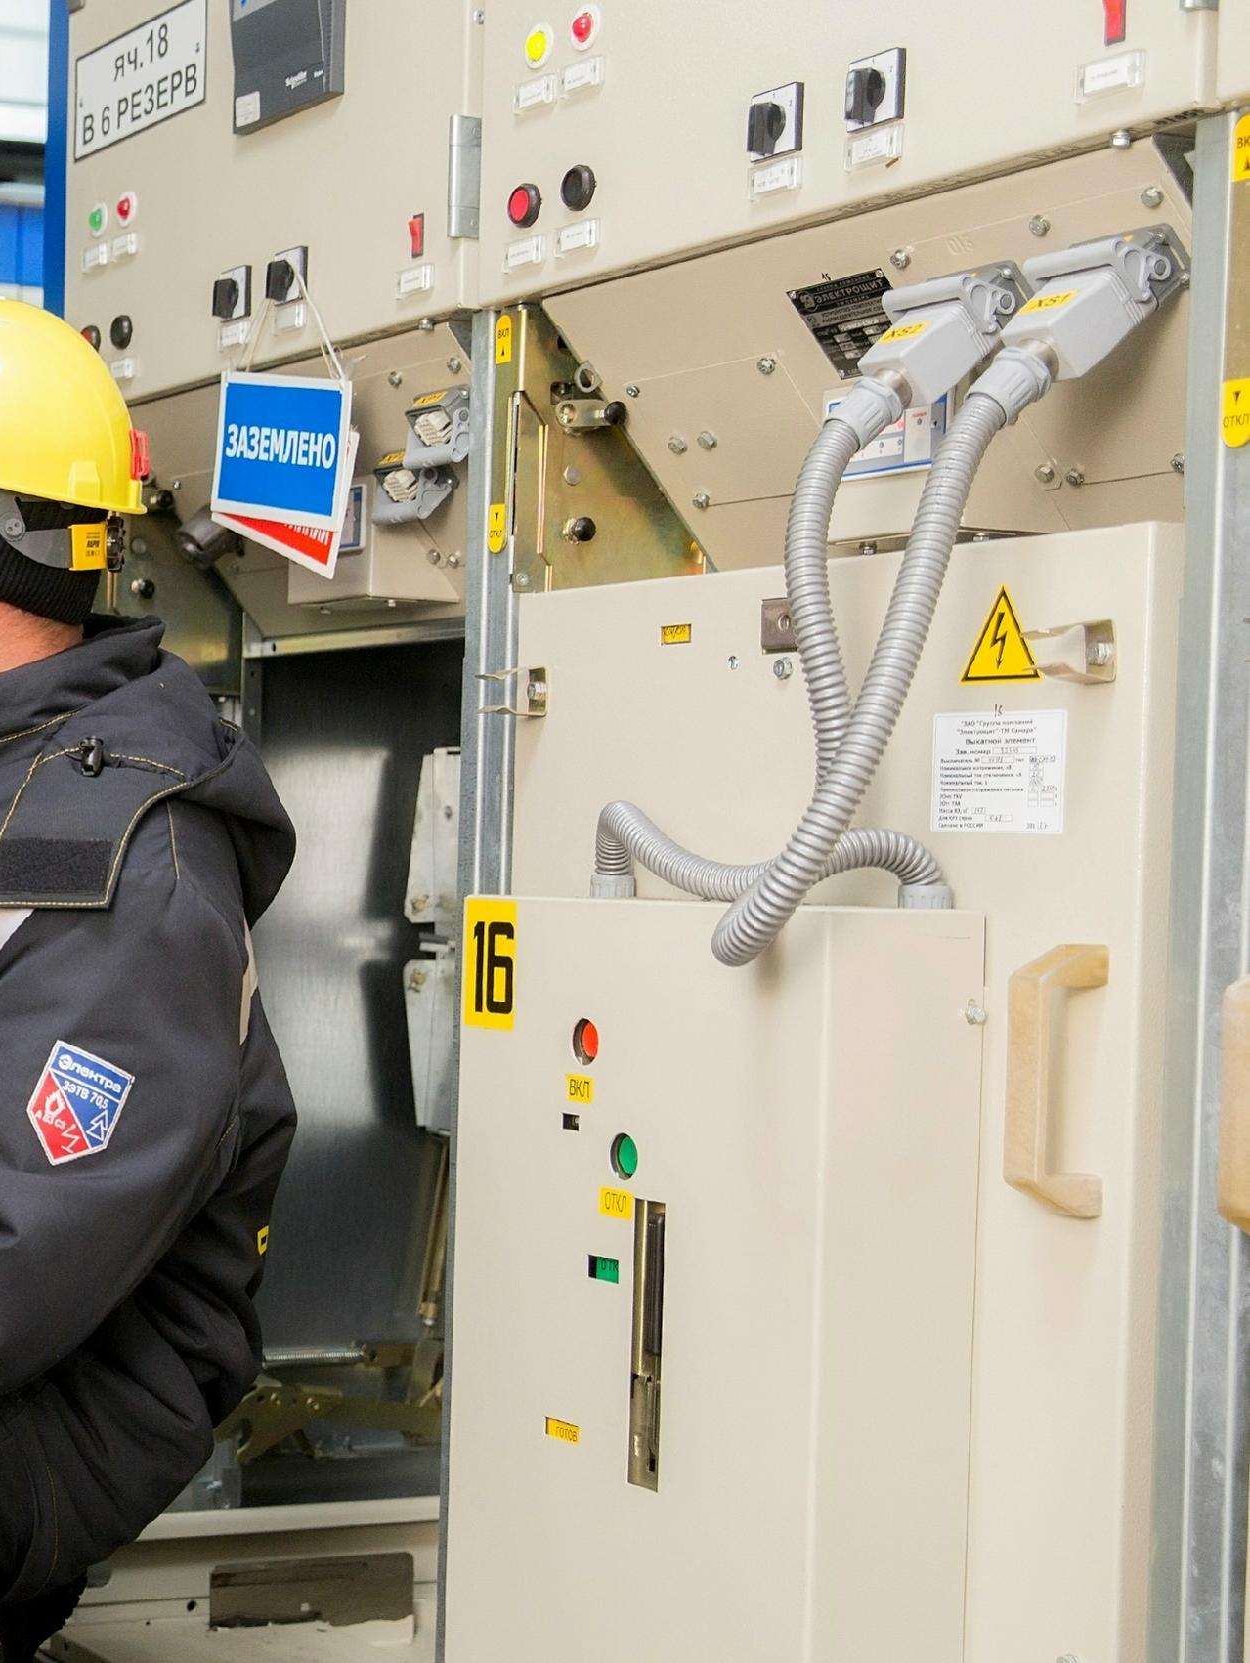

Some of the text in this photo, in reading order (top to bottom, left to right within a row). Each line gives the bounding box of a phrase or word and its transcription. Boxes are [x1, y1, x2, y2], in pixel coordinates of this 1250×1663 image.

[82, 63, 198, 146] В 6 РЕЗЕРВ
[1237, 134, 1250, 150] ВК
[814, 278, 885, 304] ЭЛЕКТРОЩИТ
[1223, 412, 1250, 429] ОТКЛ
[225, 423, 337, 470] ЗАЗЕМЛЕНО
[473, 920, 515, 1015] 16
[58, 1053, 122, 1093] Электра
[569, 1079, 590, 1099] ВКЛ
[604, 1191, 627, 1213] ОТКЛ
